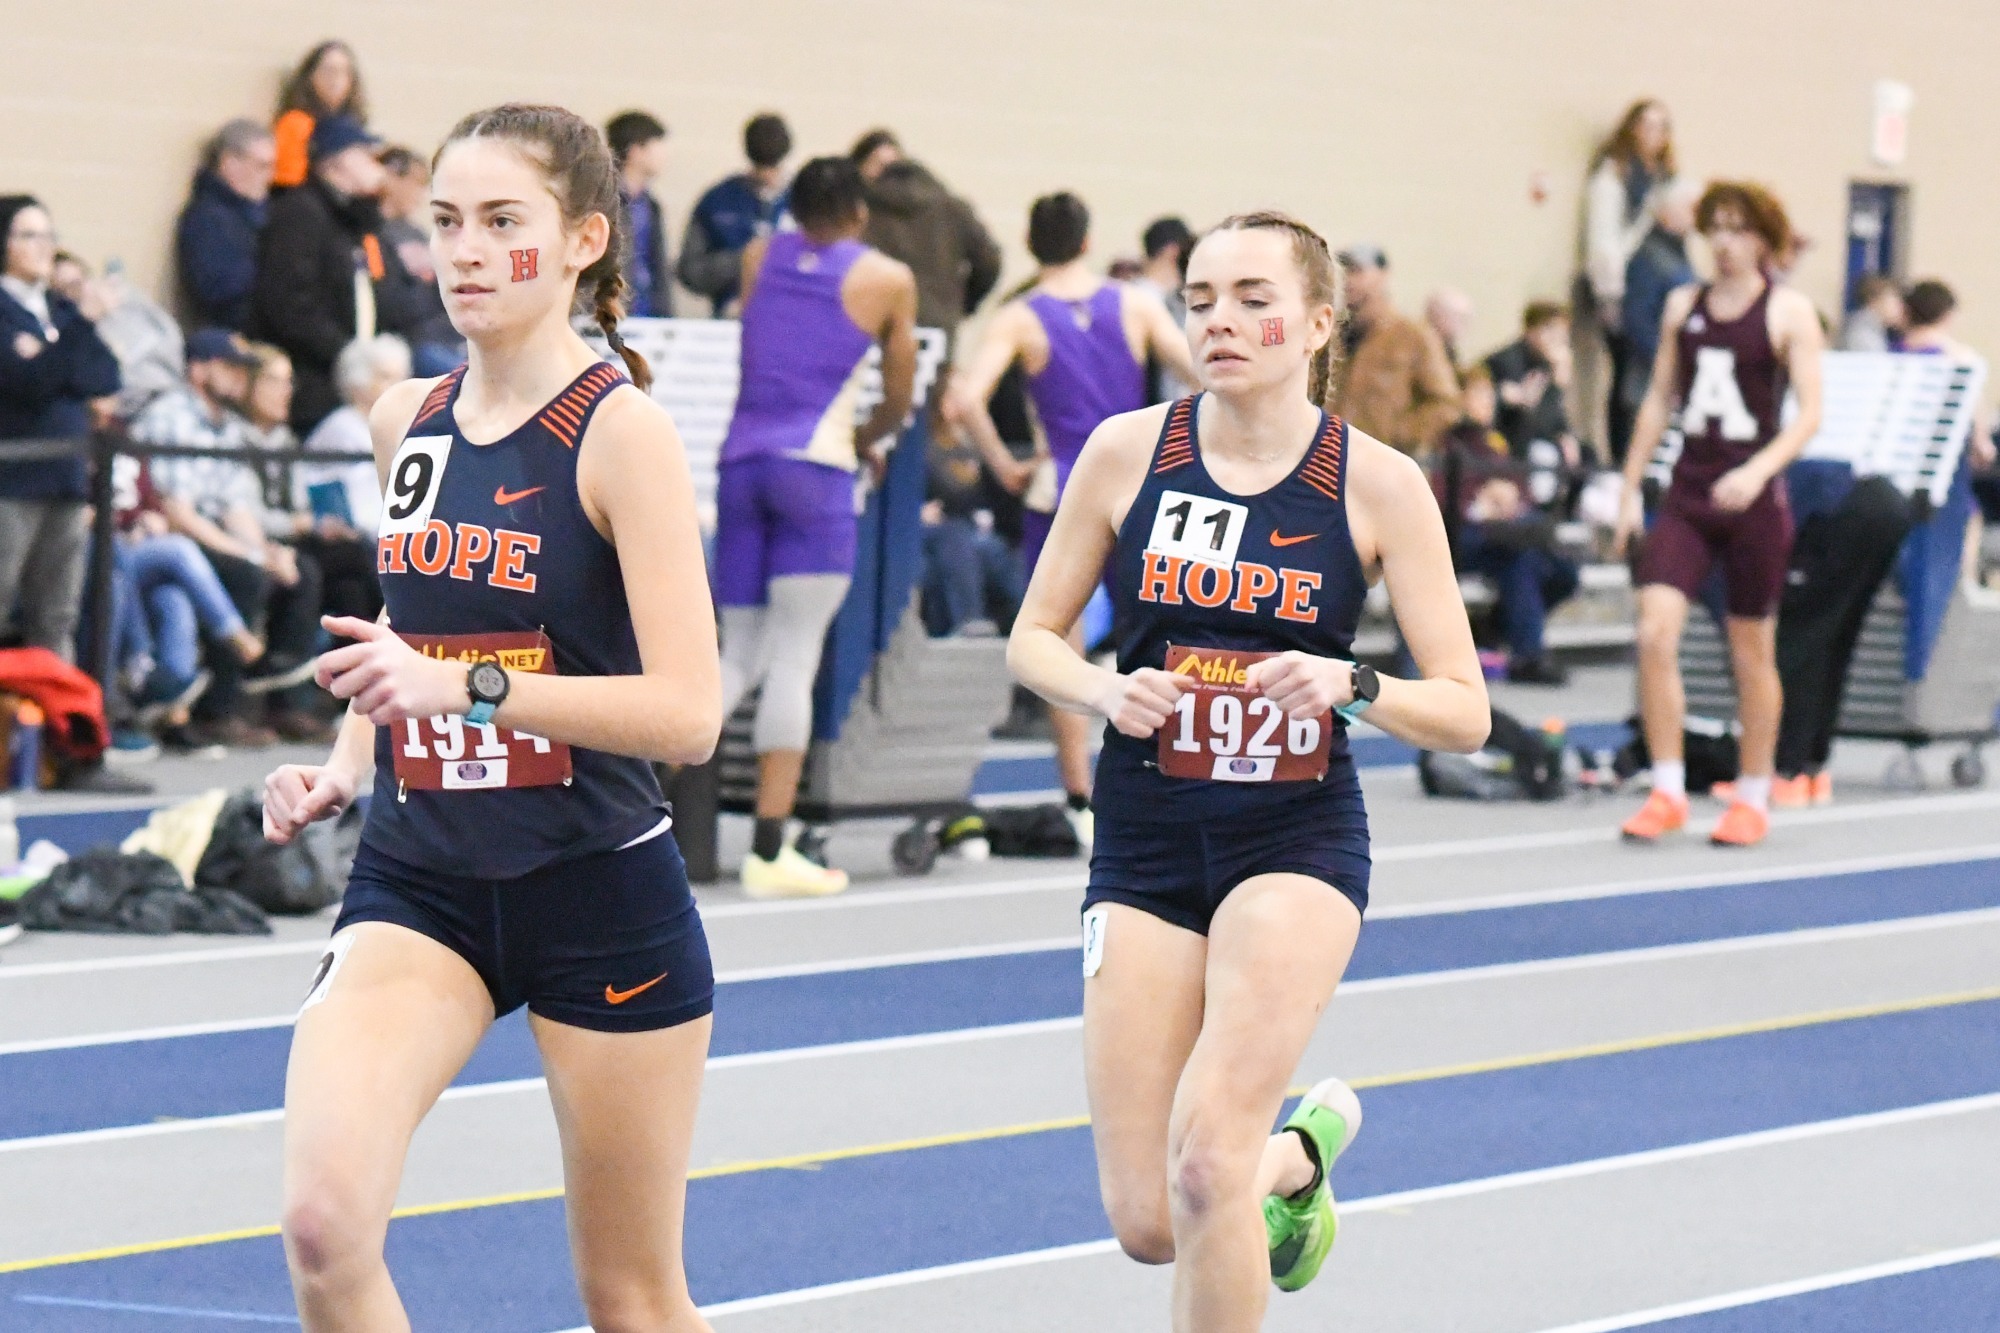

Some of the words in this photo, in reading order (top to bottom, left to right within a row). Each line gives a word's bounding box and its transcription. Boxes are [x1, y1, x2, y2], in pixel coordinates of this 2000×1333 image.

[510, 248, 538, 282] H
[1259, 316, 1285, 347] H
[1681, 346, 1759, 440] A
[389, 453, 433, 520] 9
[1165, 500, 1232, 551] 11
[378, 519, 541, 593] HOPE
[1139, 549, 1322, 623] HOPE
[503, 653, 538, 668] NET
[1173, 654, 1247, 685] Athle
[1173, 692, 1321, 757] 1926
